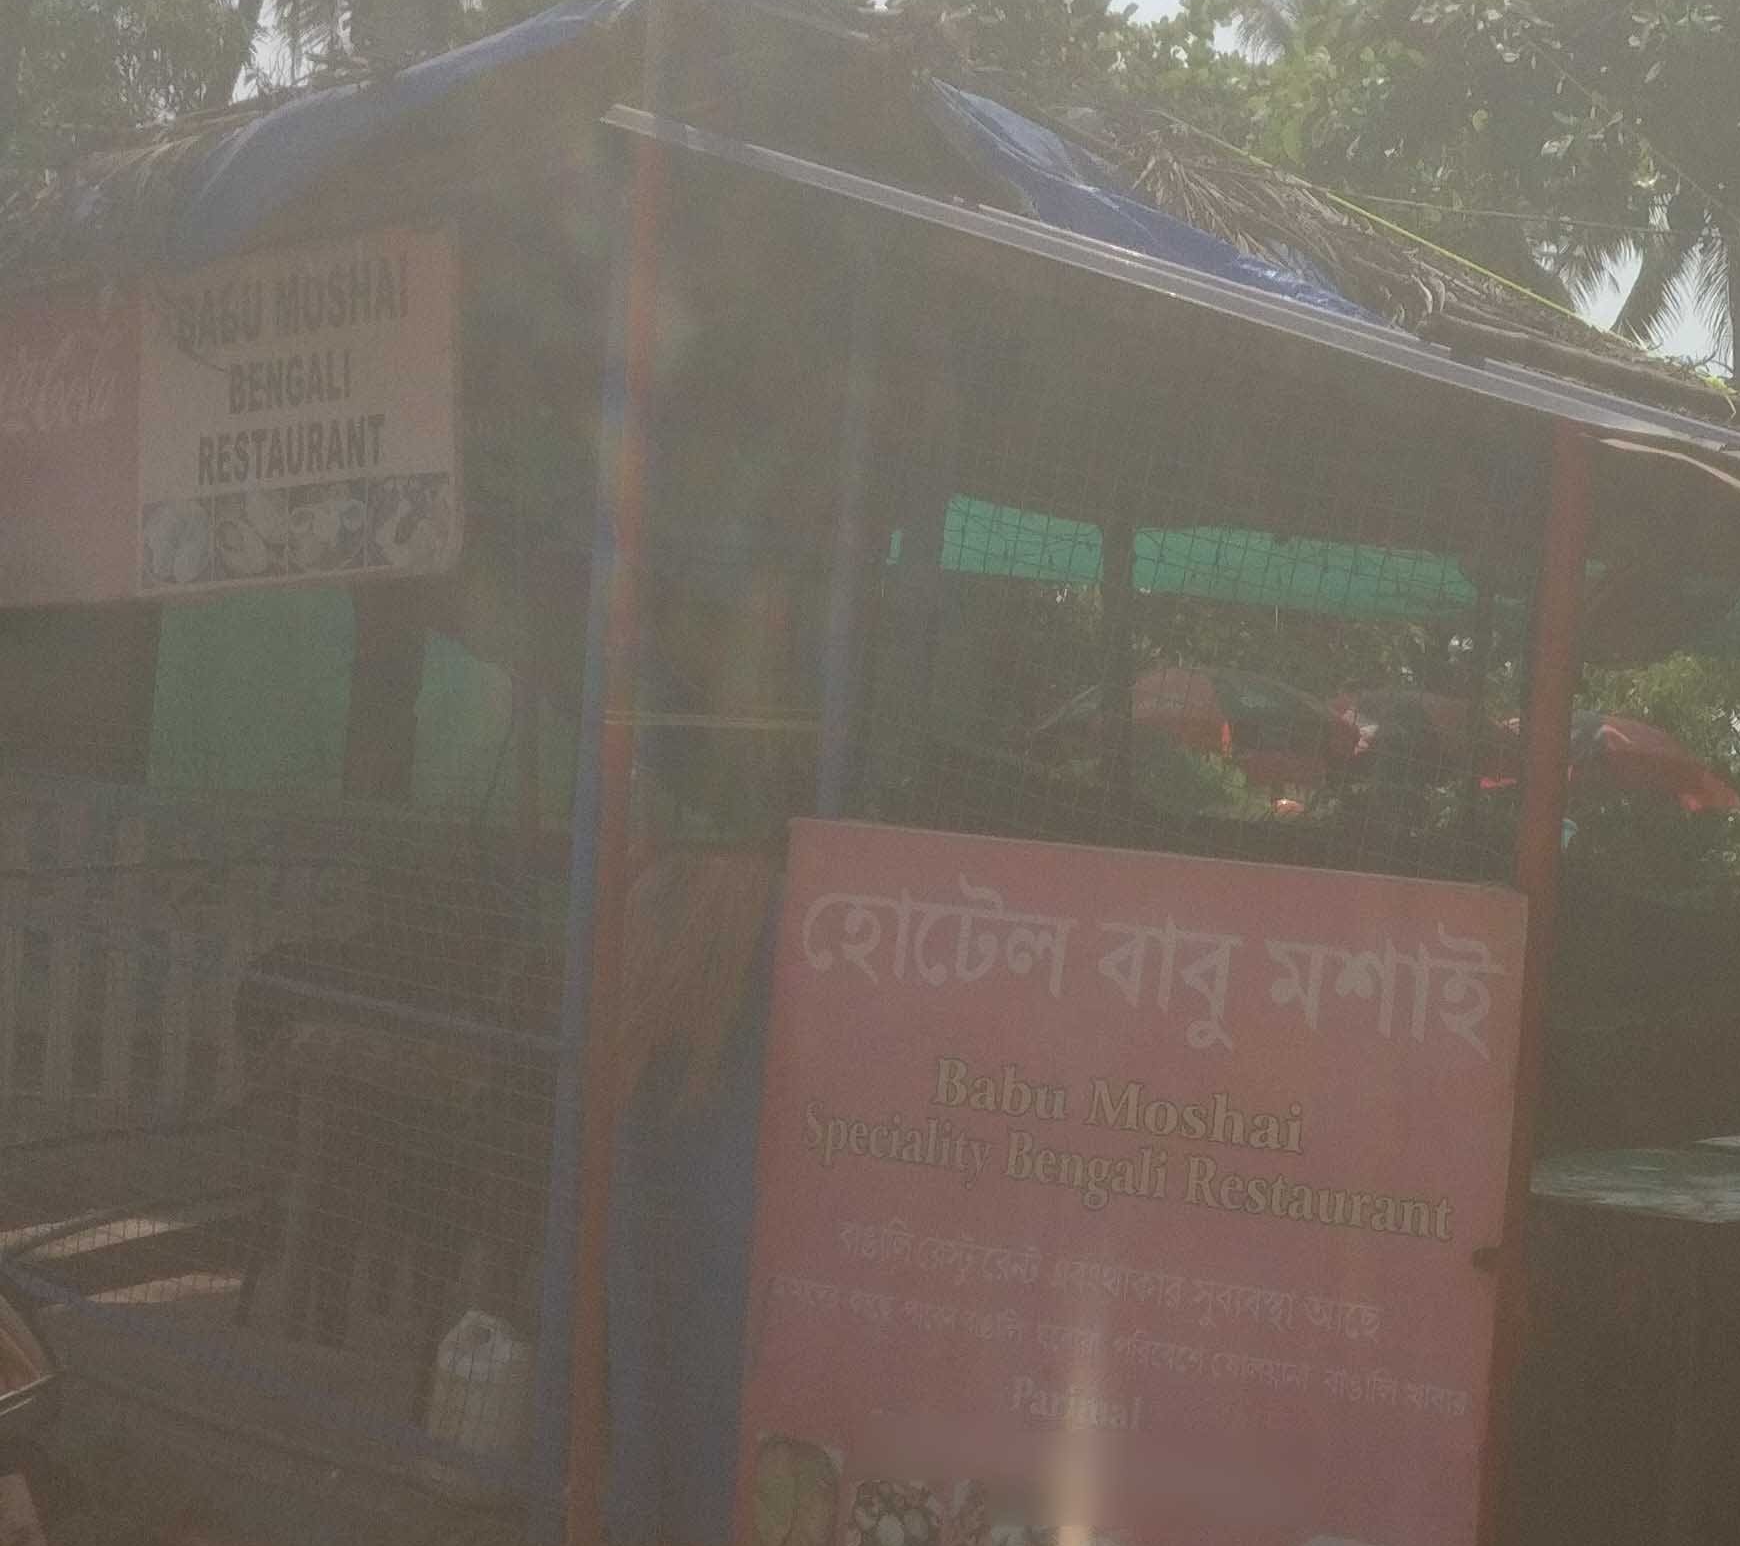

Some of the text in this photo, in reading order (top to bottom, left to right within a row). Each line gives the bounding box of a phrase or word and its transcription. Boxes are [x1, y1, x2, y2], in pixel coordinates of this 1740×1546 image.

[275, 253, 408, 338] MOSHAI
[228, 350, 350, 414] BENGALI
[198, 415, 385, 486] RESTAURANT
[800, 873, 1506, 1059] হোটেল বাবু মশাই
[935, 1055, 1304, 1154] Babu Moshai
[805, 1103, 1454, 1241] Speciality Bengali Restaurant
